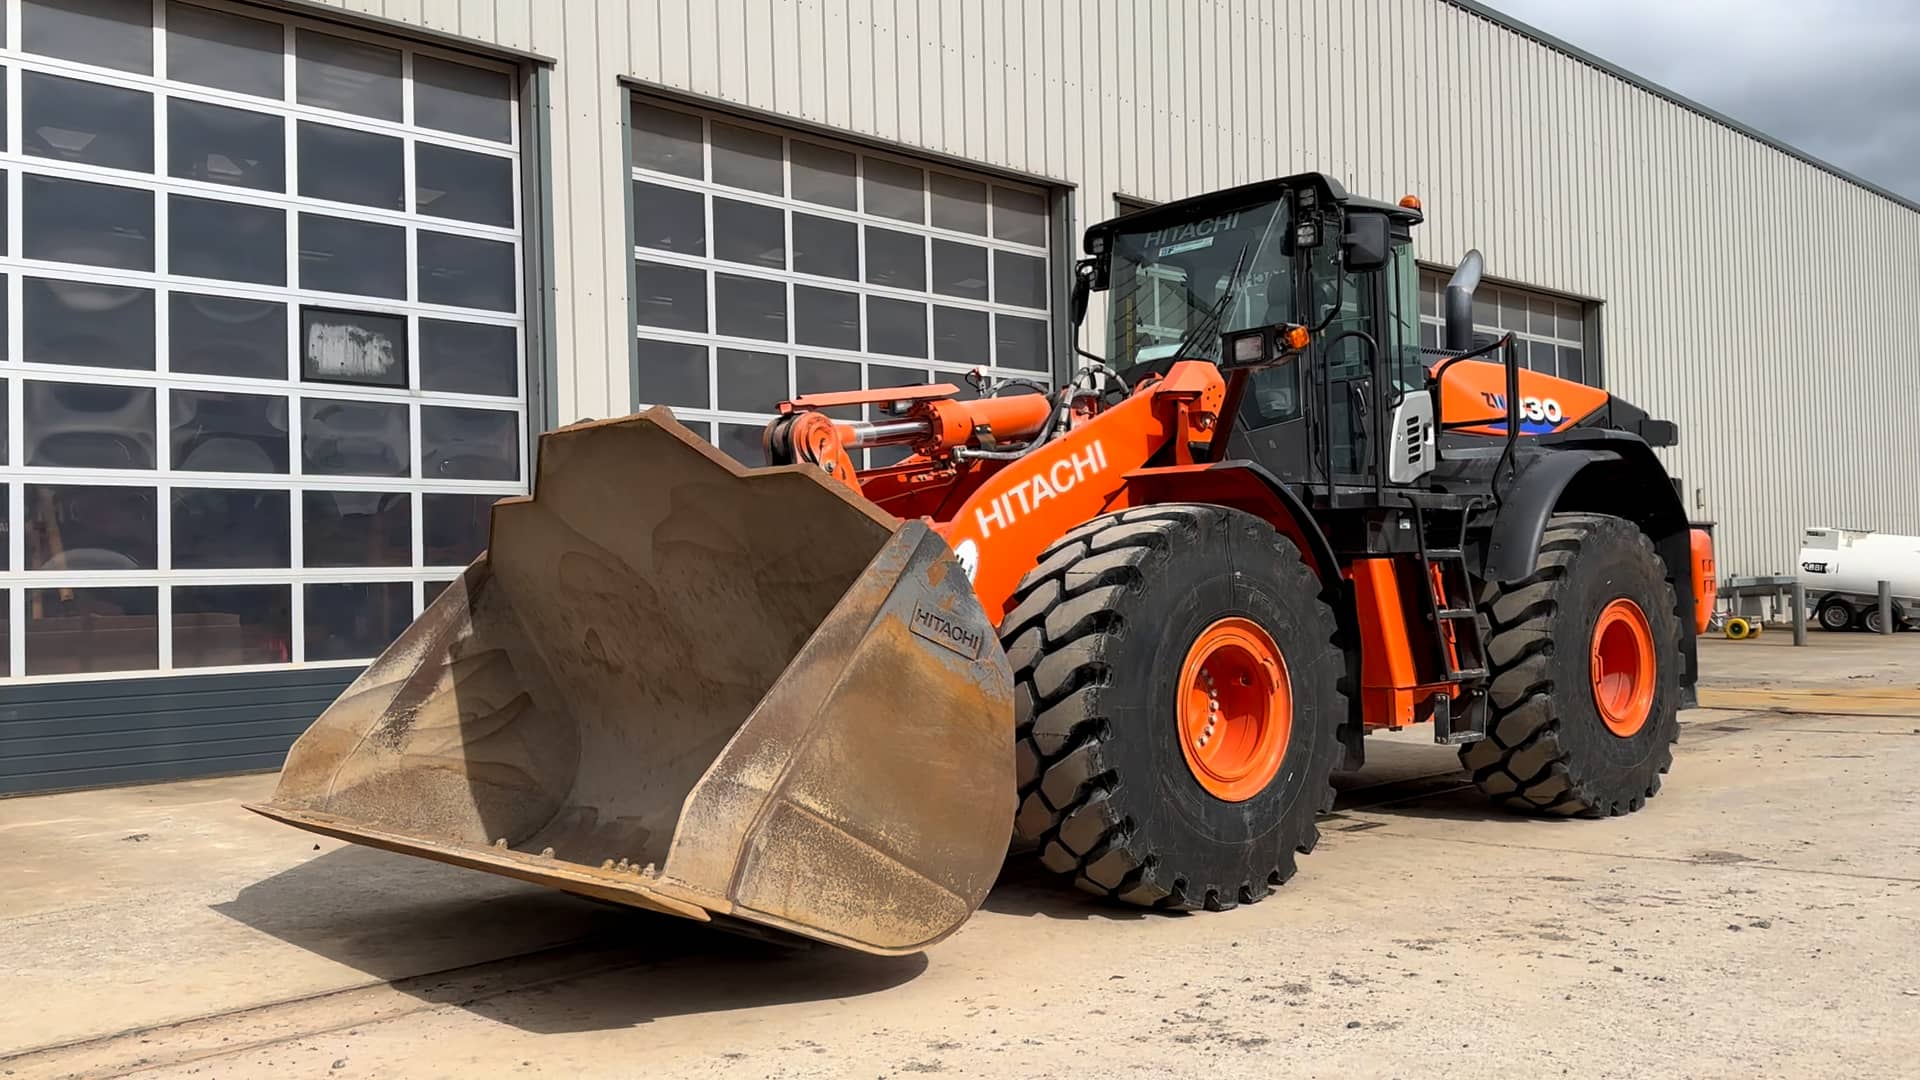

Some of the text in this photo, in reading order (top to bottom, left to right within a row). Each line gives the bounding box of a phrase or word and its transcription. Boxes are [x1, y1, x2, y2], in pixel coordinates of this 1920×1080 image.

[1143, 211, 1240, 248] HITACHI
[975, 440, 1108, 539] HITACHI
[915, 608, 979, 650] HITACHI
